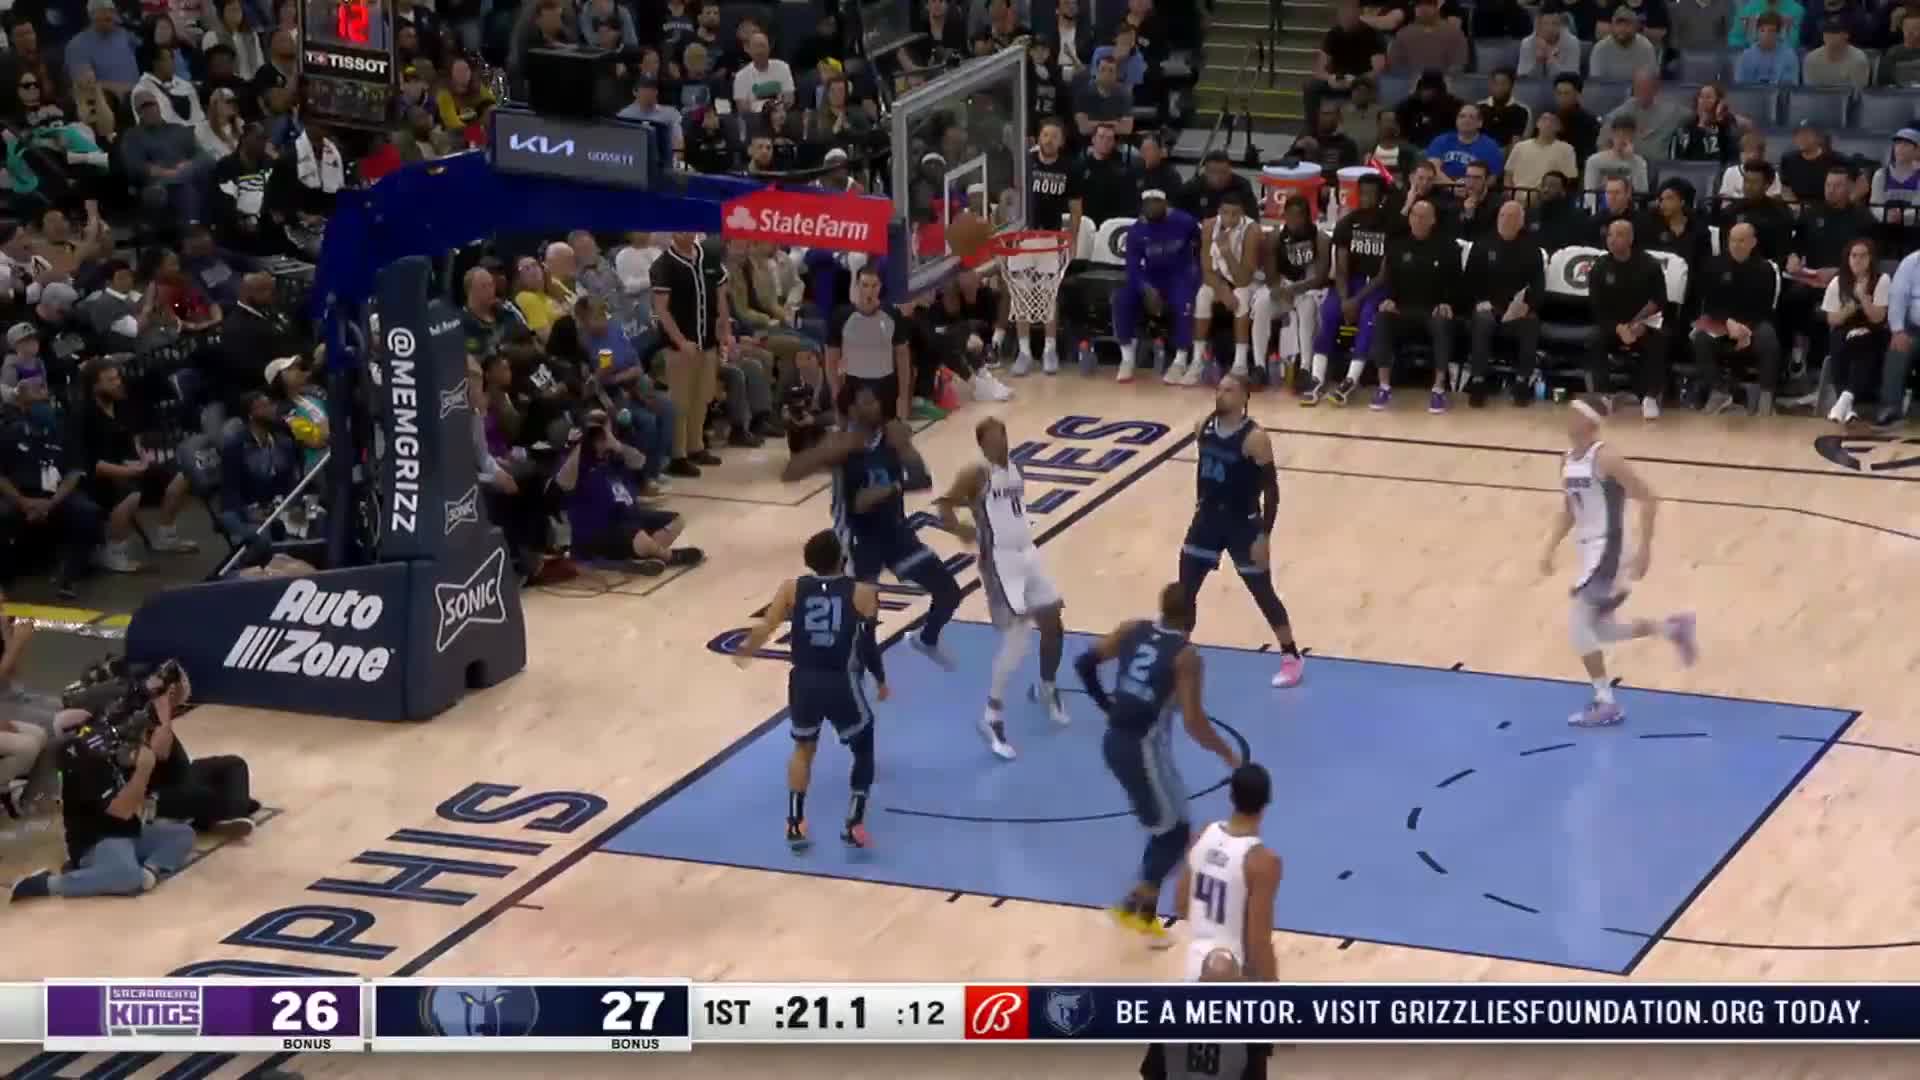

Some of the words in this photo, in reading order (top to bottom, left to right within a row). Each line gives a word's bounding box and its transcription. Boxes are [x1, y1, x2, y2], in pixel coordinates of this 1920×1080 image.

[336, 3, 369, 43] 12
[328, 54, 388, 74] TISSOT
[509, 133, 575, 157] KIA
[387, 326, 420, 534] @MEMGRIZZ
[269, 579, 383, 630] Auto
[445, 578, 497, 626] SONIC
[805, 595, 842, 631] 21
[265, 629, 391, 682] Zone
[1128, 643, 1158, 681] 2
[1195, 871, 1227, 926] 41
